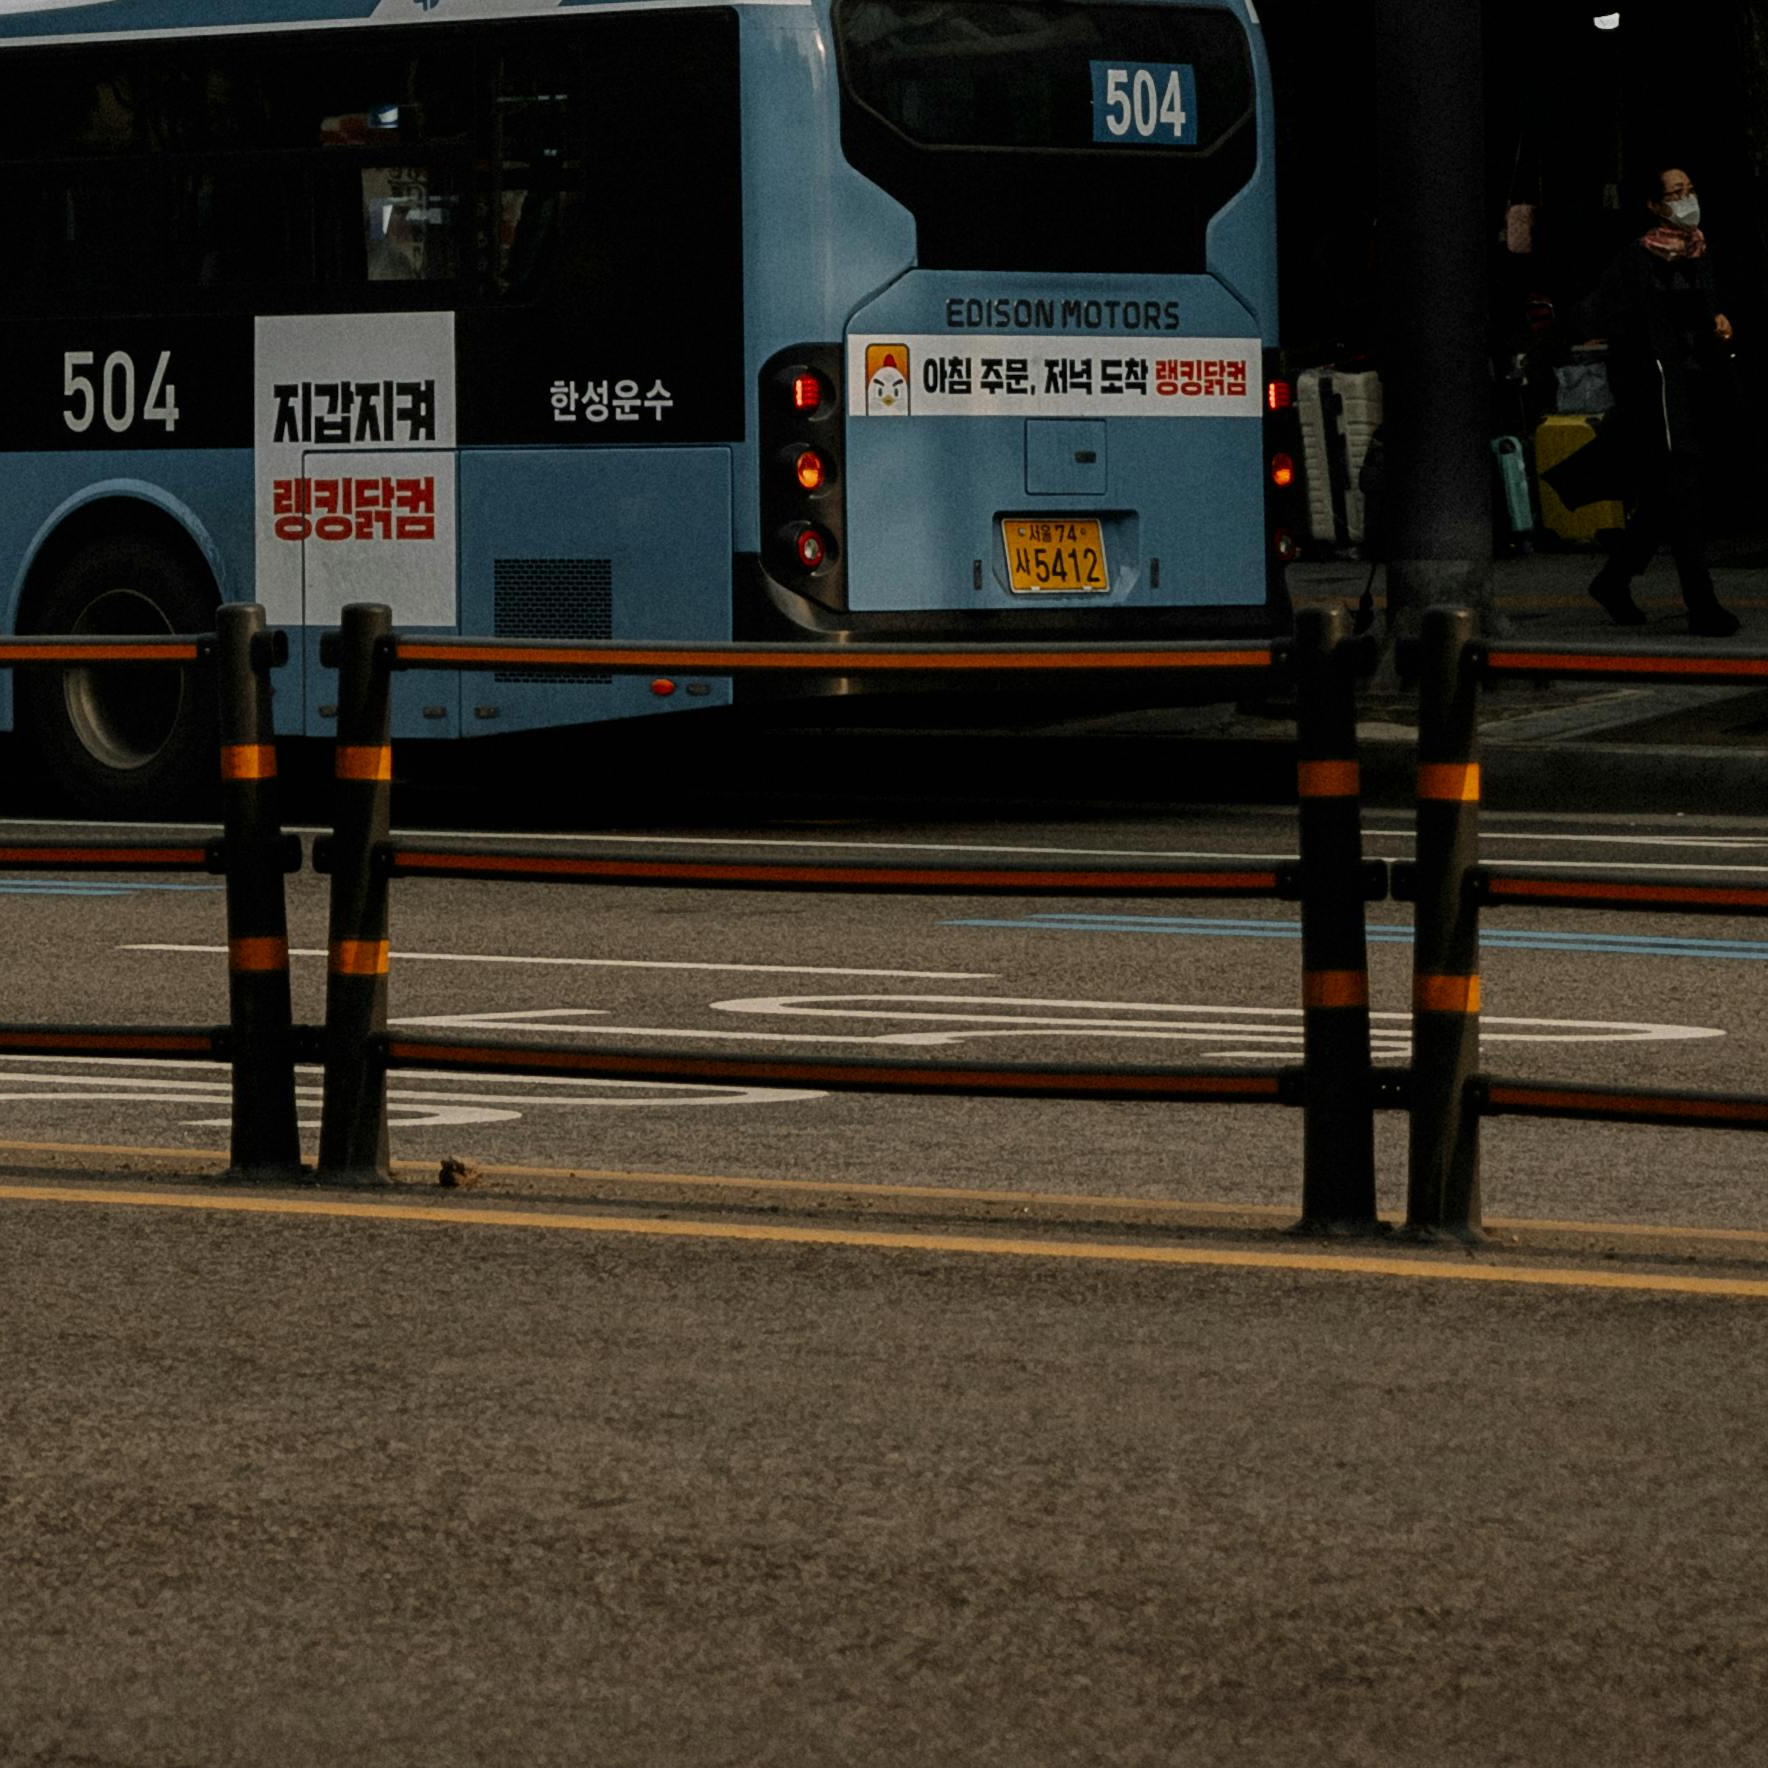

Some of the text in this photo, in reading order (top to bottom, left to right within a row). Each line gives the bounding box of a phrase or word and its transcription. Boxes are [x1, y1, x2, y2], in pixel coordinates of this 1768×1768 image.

[1105, 68, 1187, 138] 504
[946, 298, 1180, 331] EDISON MOTORS
[61, 349, 180, 433] 504
[549, 377, 675, 424] 한성운수
[923, 356, 1248, 396] 아침 주문, 저녁 도착 랭킹닭컴
[273, 379, 436, 444] 지갑지켜
[273, 476, 436, 541] 랭킹닭컴
